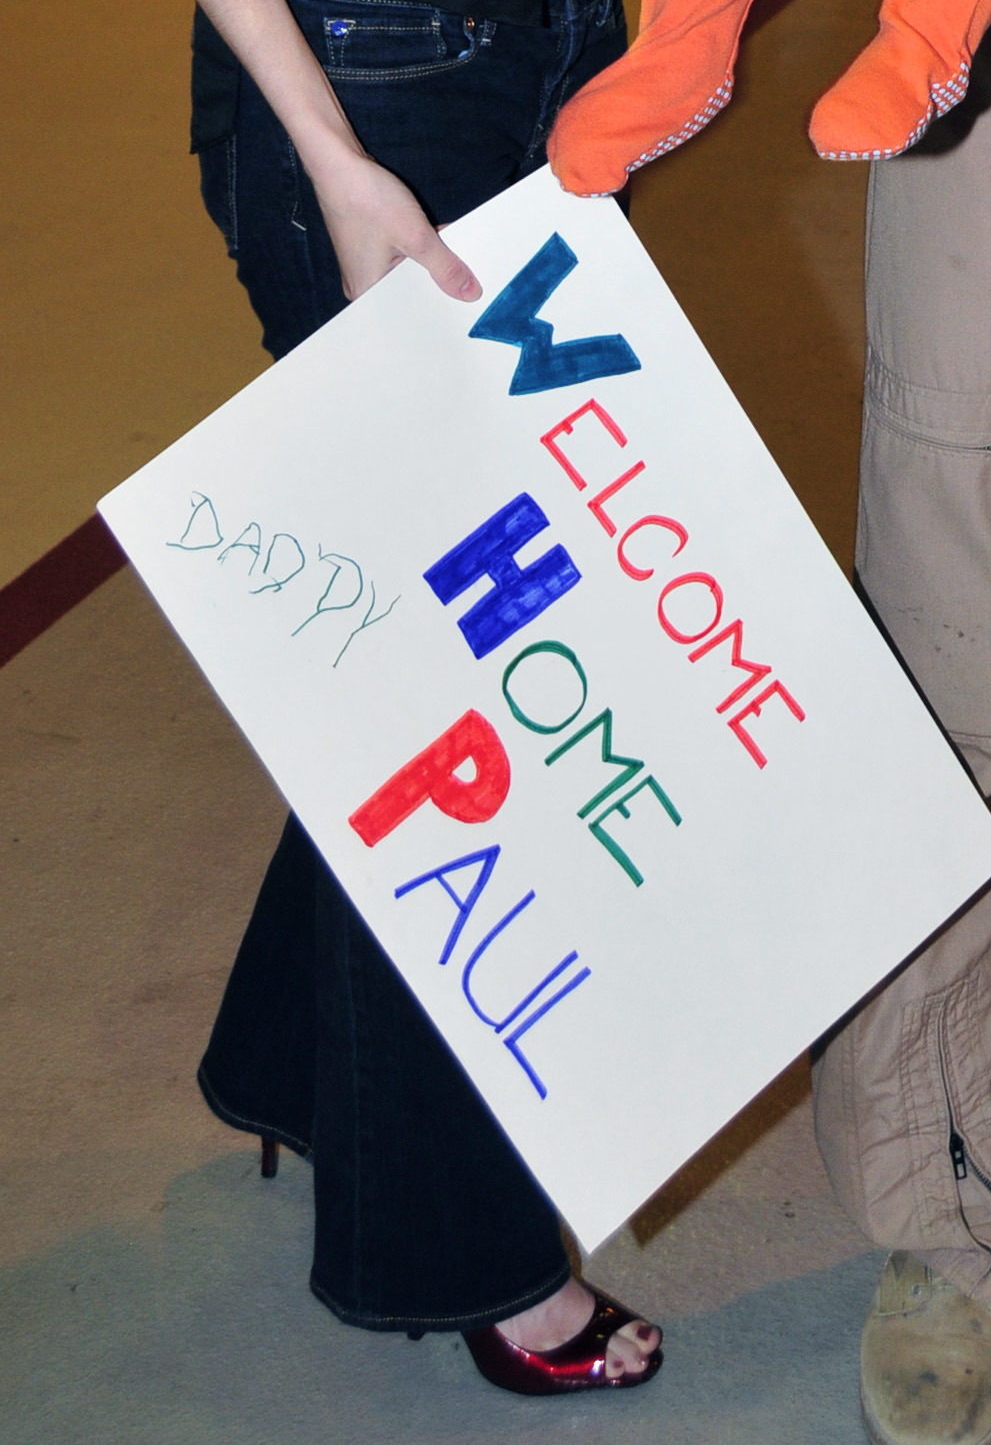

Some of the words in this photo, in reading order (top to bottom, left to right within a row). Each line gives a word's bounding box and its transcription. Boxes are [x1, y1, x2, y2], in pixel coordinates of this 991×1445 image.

[166, 491, 401, 668] DADDY
[423, 492, 682, 886] HOME
[468, 232, 807, 770] WELCOME
[348, 708, 592, 1100] PAUL
